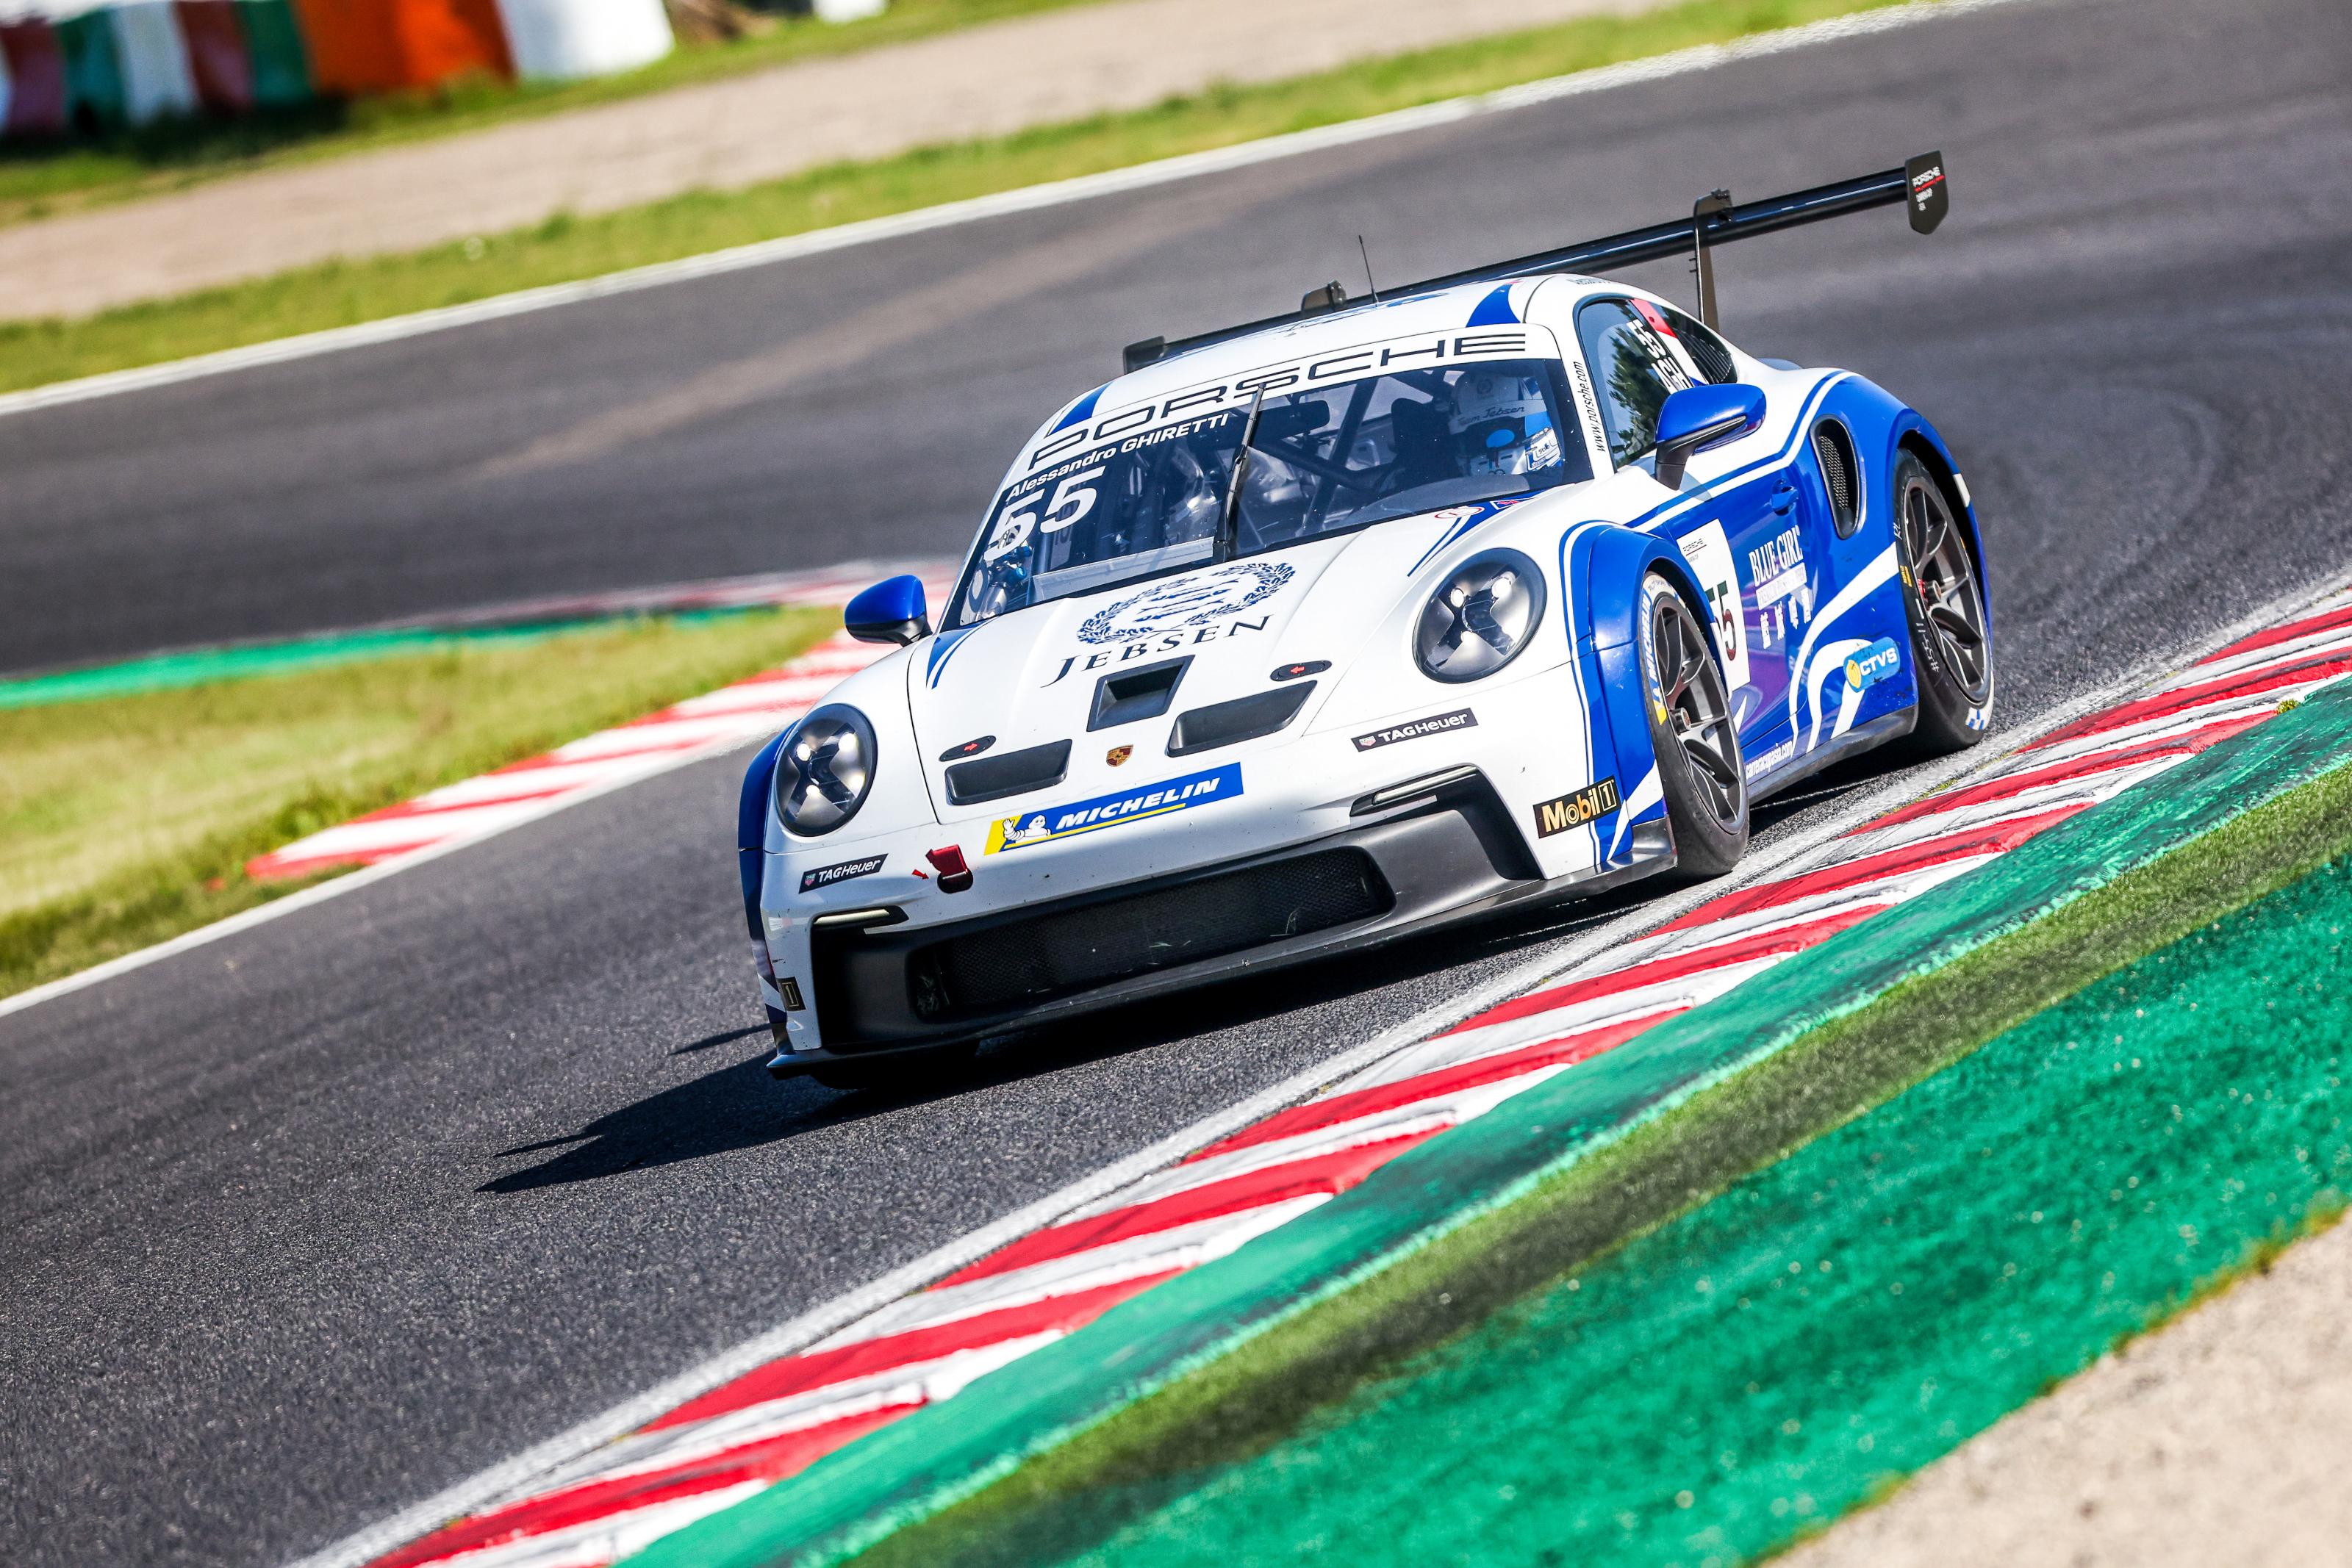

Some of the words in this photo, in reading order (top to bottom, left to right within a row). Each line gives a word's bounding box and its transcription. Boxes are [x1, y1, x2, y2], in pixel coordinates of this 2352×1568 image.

[1626, 318, 1666, 359] 55
[1027, 332, 1527, 472] PORSCHE
[1573, 361, 1606, 453] www.porsche.com
[1651, 356, 1695, 395] AGH
[1005, 445, 1116, 503] Alessandro
[1120, 413, 1229, 453] GHIRETTI
[983, 465, 1106, 562] 55
[1748, 540, 1779, 587] BLUE
[1039, 614, 1275, 688] JEBSEN
[1641, 593, 1658, 683] MICHELIN
[1859, 647, 1898, 677] CTVS
[1055, 777, 1221, 830] MICHELIN
[1541, 786, 1602, 832] Mobil
